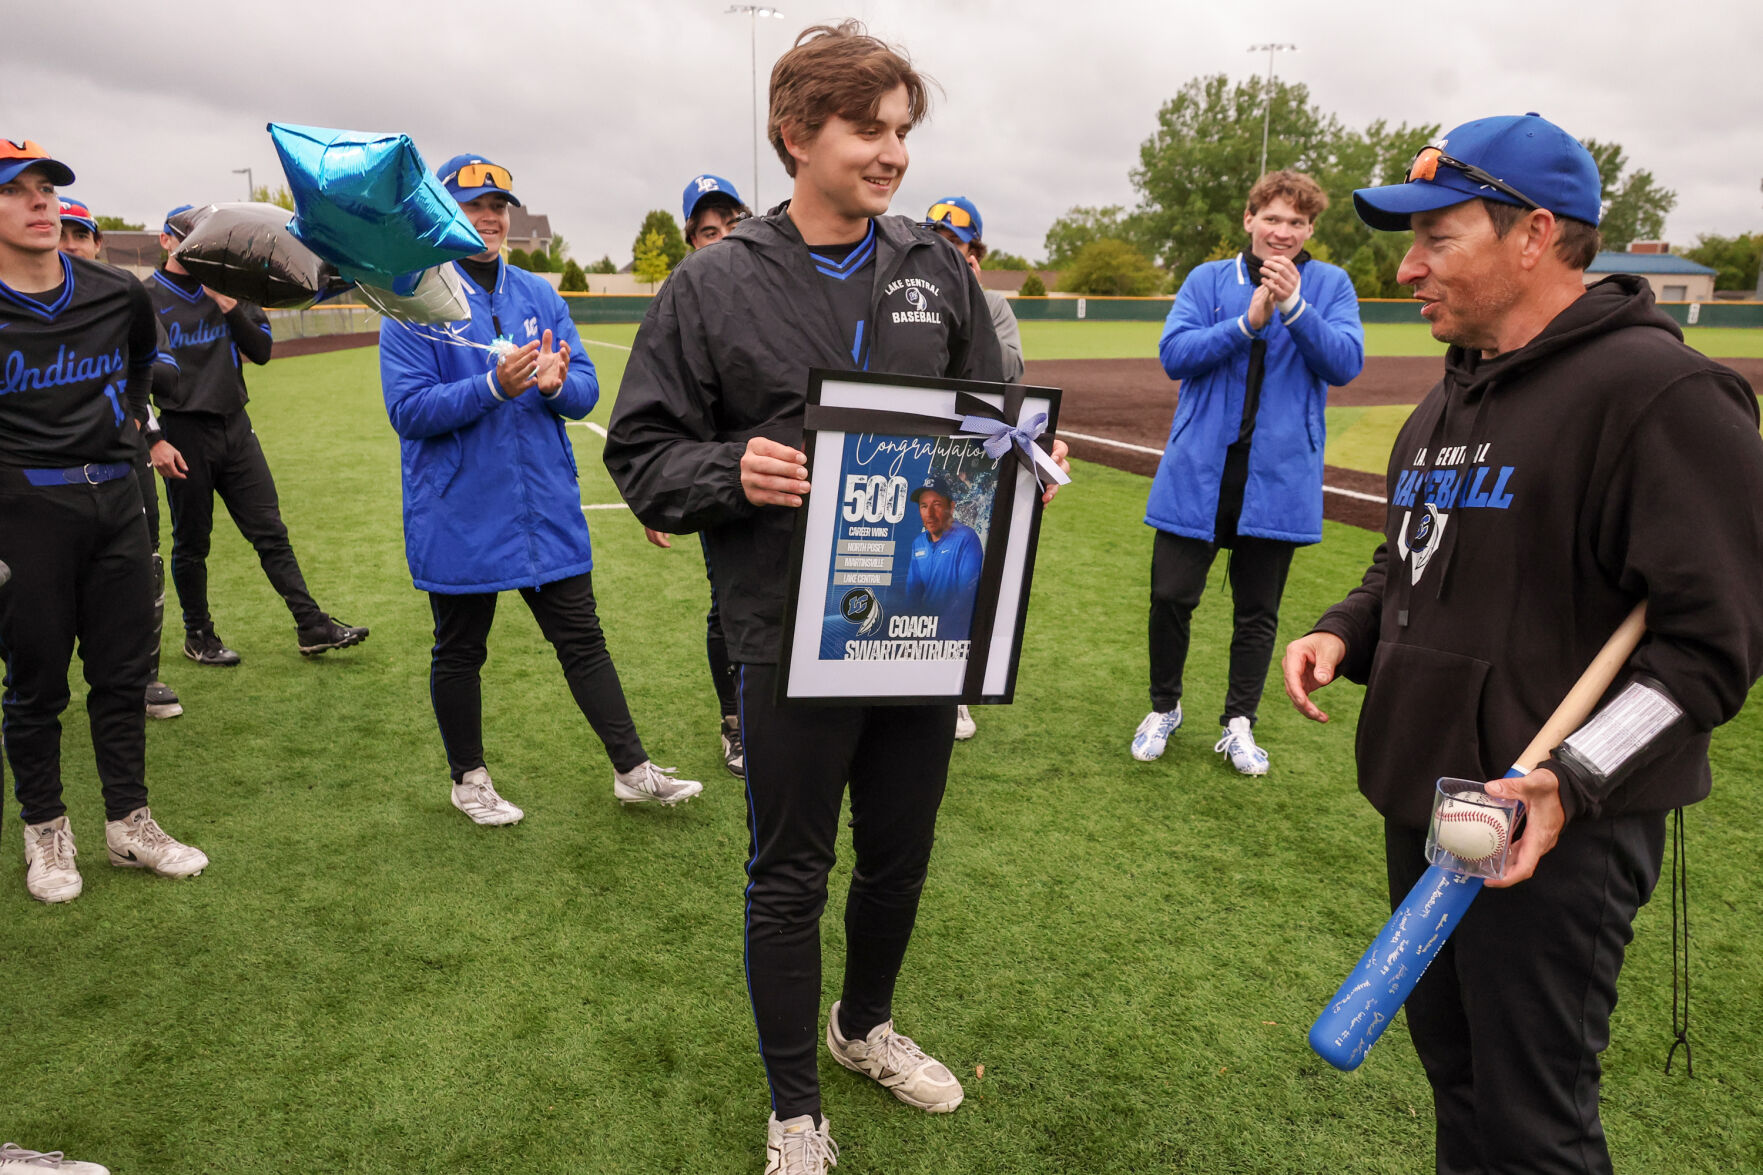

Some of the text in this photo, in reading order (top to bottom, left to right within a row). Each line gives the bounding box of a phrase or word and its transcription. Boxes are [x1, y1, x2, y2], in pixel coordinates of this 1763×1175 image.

[695, 176, 720, 193] LC
[884, 278, 940, 297] LAKE CENTRAL
[891, 311, 942, 324] BASEBALL
[169, 319, 231, 349] Indian
[0, 344, 124, 395] Indians
[1413, 443, 1492, 467] LA CENTL
[843, 474, 909, 524] 500
[848, 526, 889, 538] CAREER WINS
[847, 542, 886, 553] NORTH POSEY
[844, 557, 884, 568] MARTINSVILLE
[843, 574, 881, 584] LAKE CENTRAL
[847, 594, 868, 616] LC
[888, 615, 939, 638] COACH
